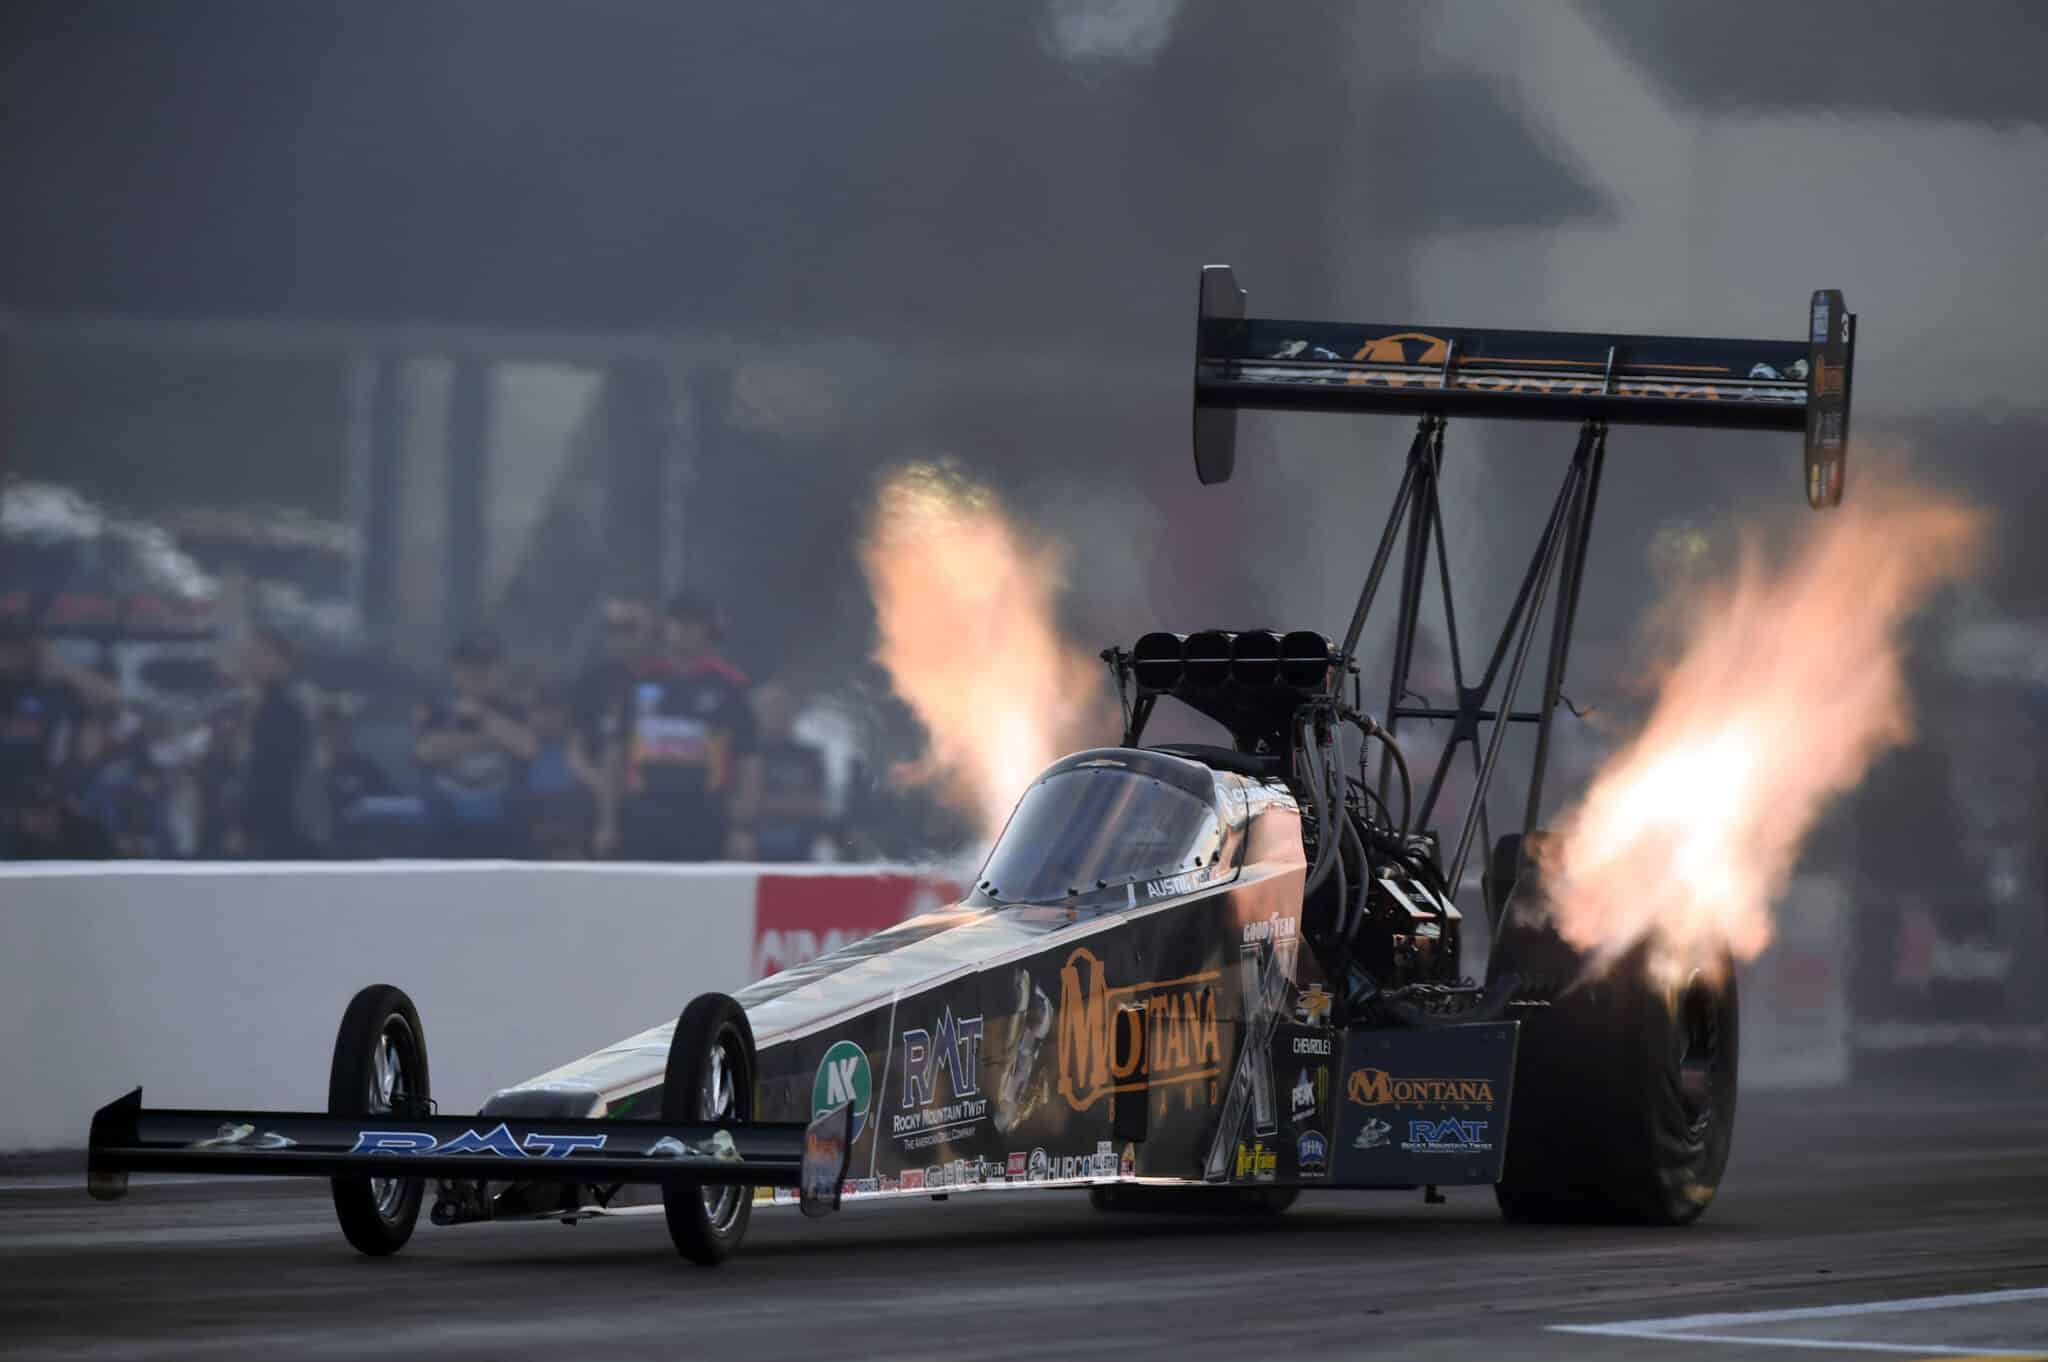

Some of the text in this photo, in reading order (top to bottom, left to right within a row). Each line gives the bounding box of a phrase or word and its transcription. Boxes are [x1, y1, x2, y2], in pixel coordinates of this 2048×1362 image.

[1347, 1068, 1495, 1105] MONTANA
[893, 1113, 921, 1133] ROCKY
[922, 1104, 962, 1127] MOUNTAIN
